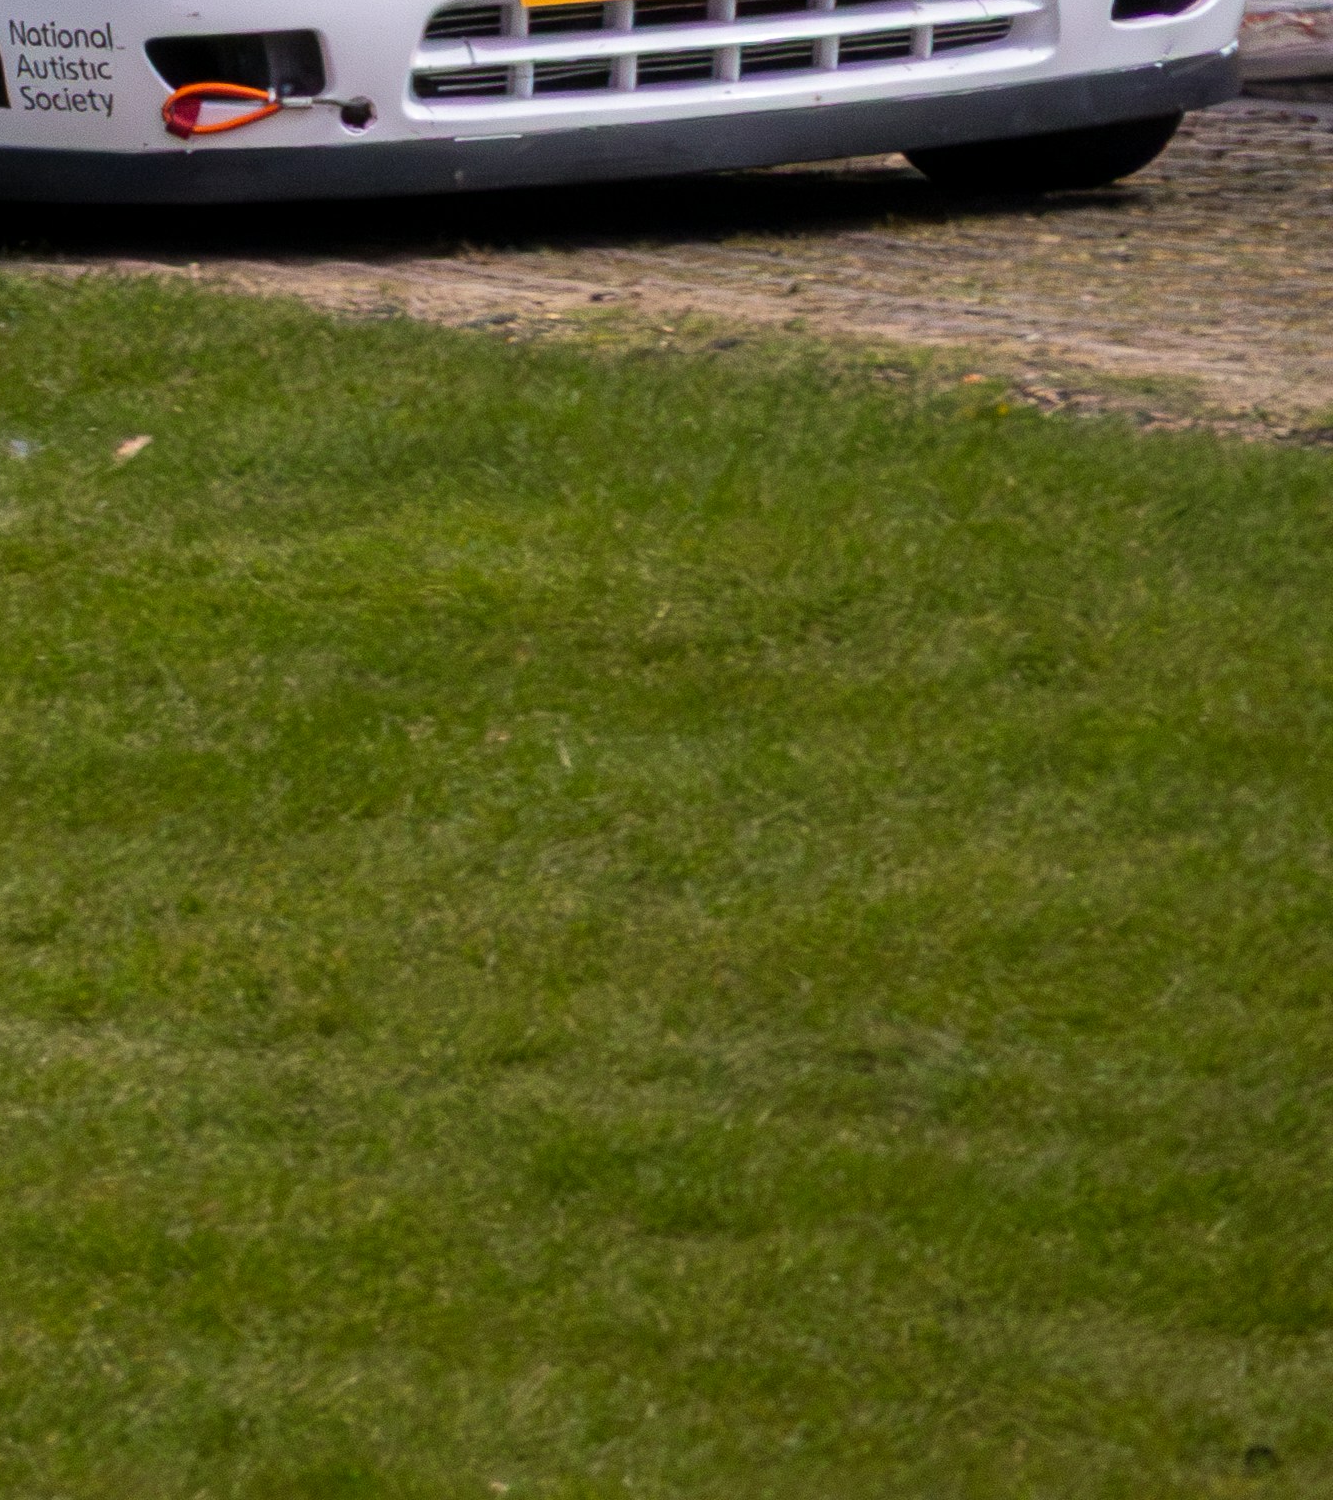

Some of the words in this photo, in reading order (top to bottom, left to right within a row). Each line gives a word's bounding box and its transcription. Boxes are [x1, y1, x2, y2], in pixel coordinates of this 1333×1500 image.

[9, 19, 114, 50] National
[17, 53, 113, 80] Autistic
[20, 85, 114, 118] Society
